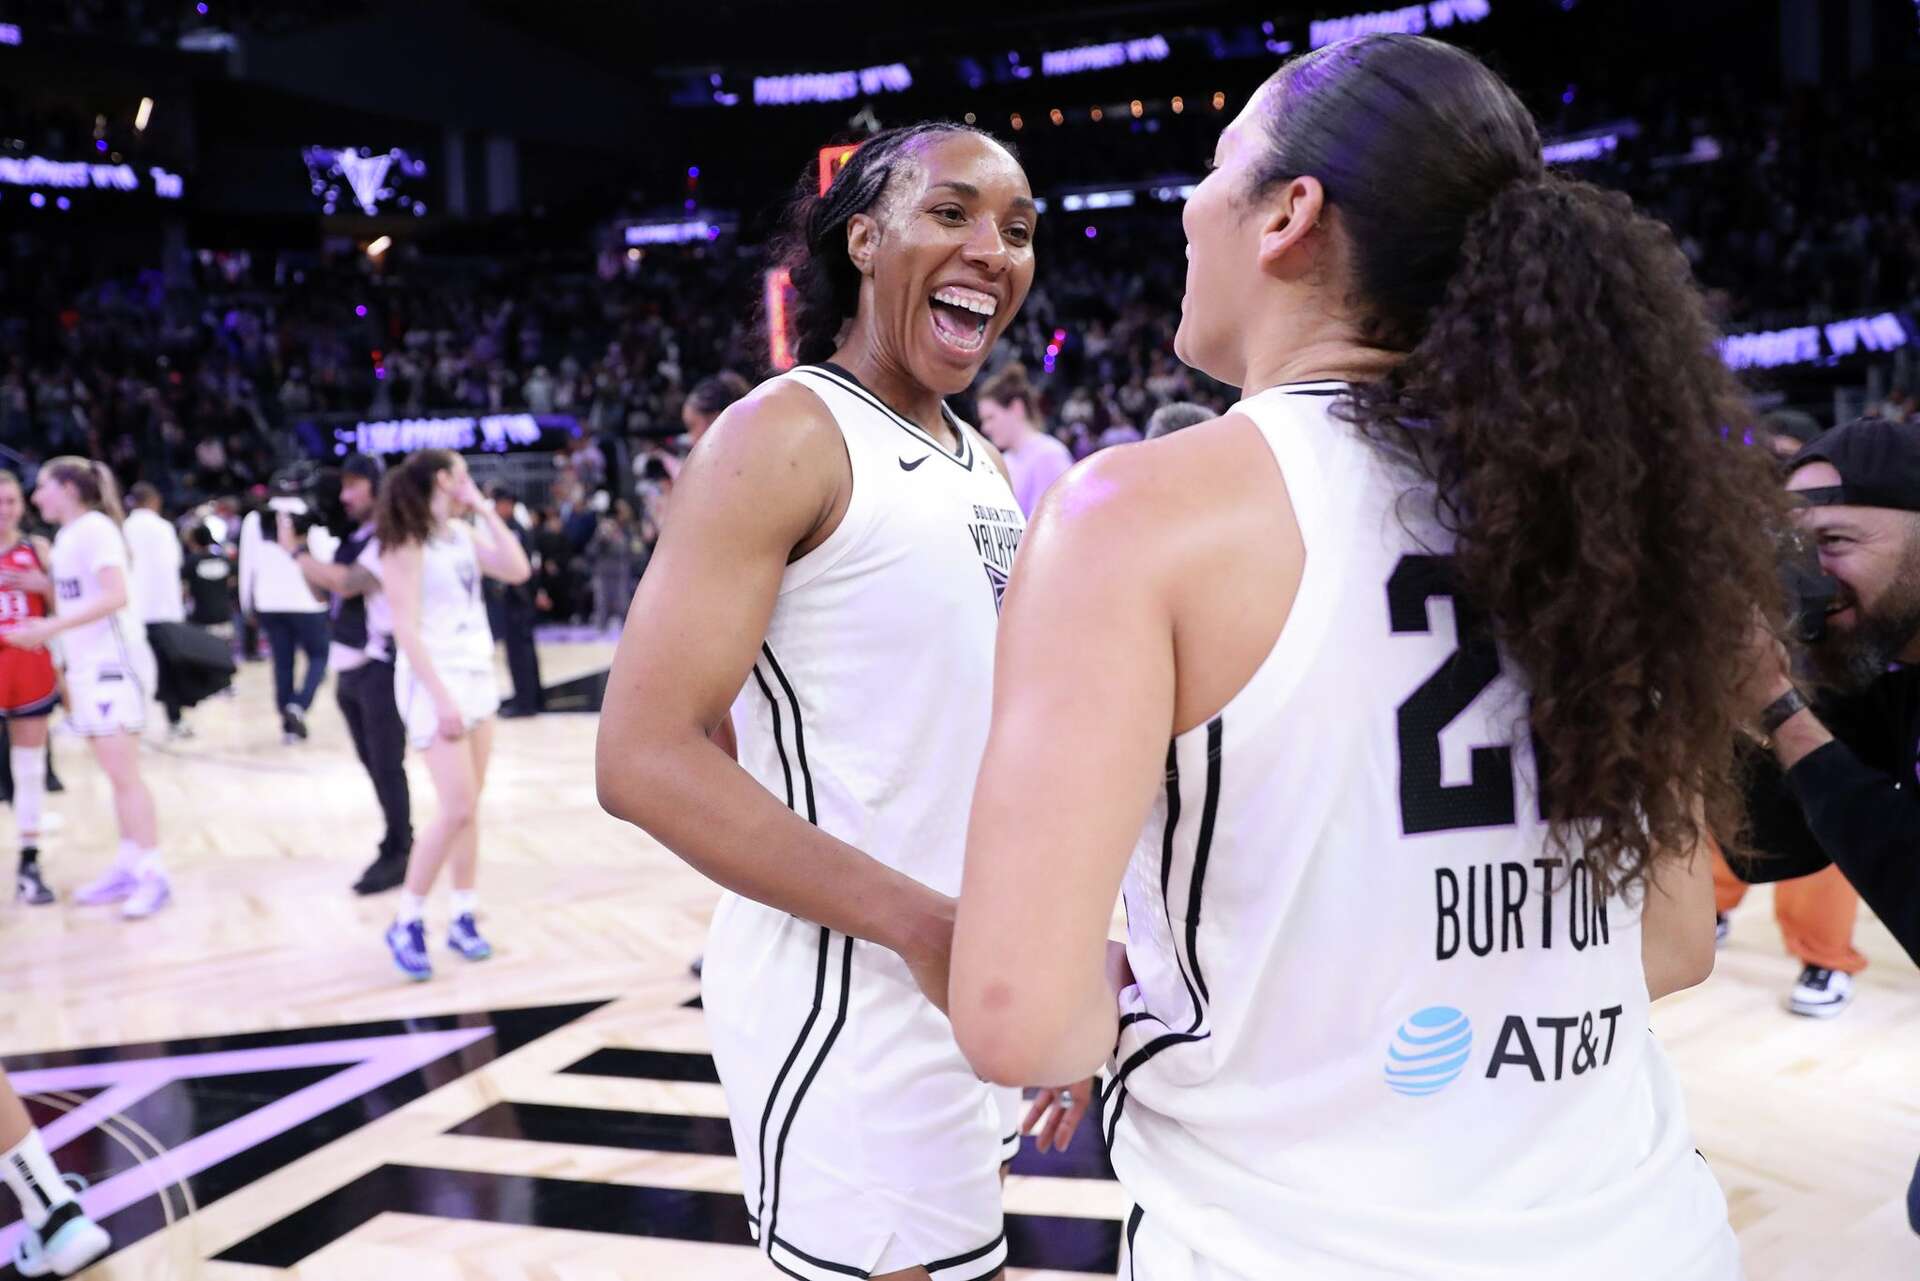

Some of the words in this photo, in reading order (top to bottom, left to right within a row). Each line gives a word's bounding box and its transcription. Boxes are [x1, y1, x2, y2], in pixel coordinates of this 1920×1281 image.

[967, 523, 1023, 571] VALKYR
[1434, 857, 1610, 961] BURTON
[1484, 1003, 1623, 1083] AT&T
